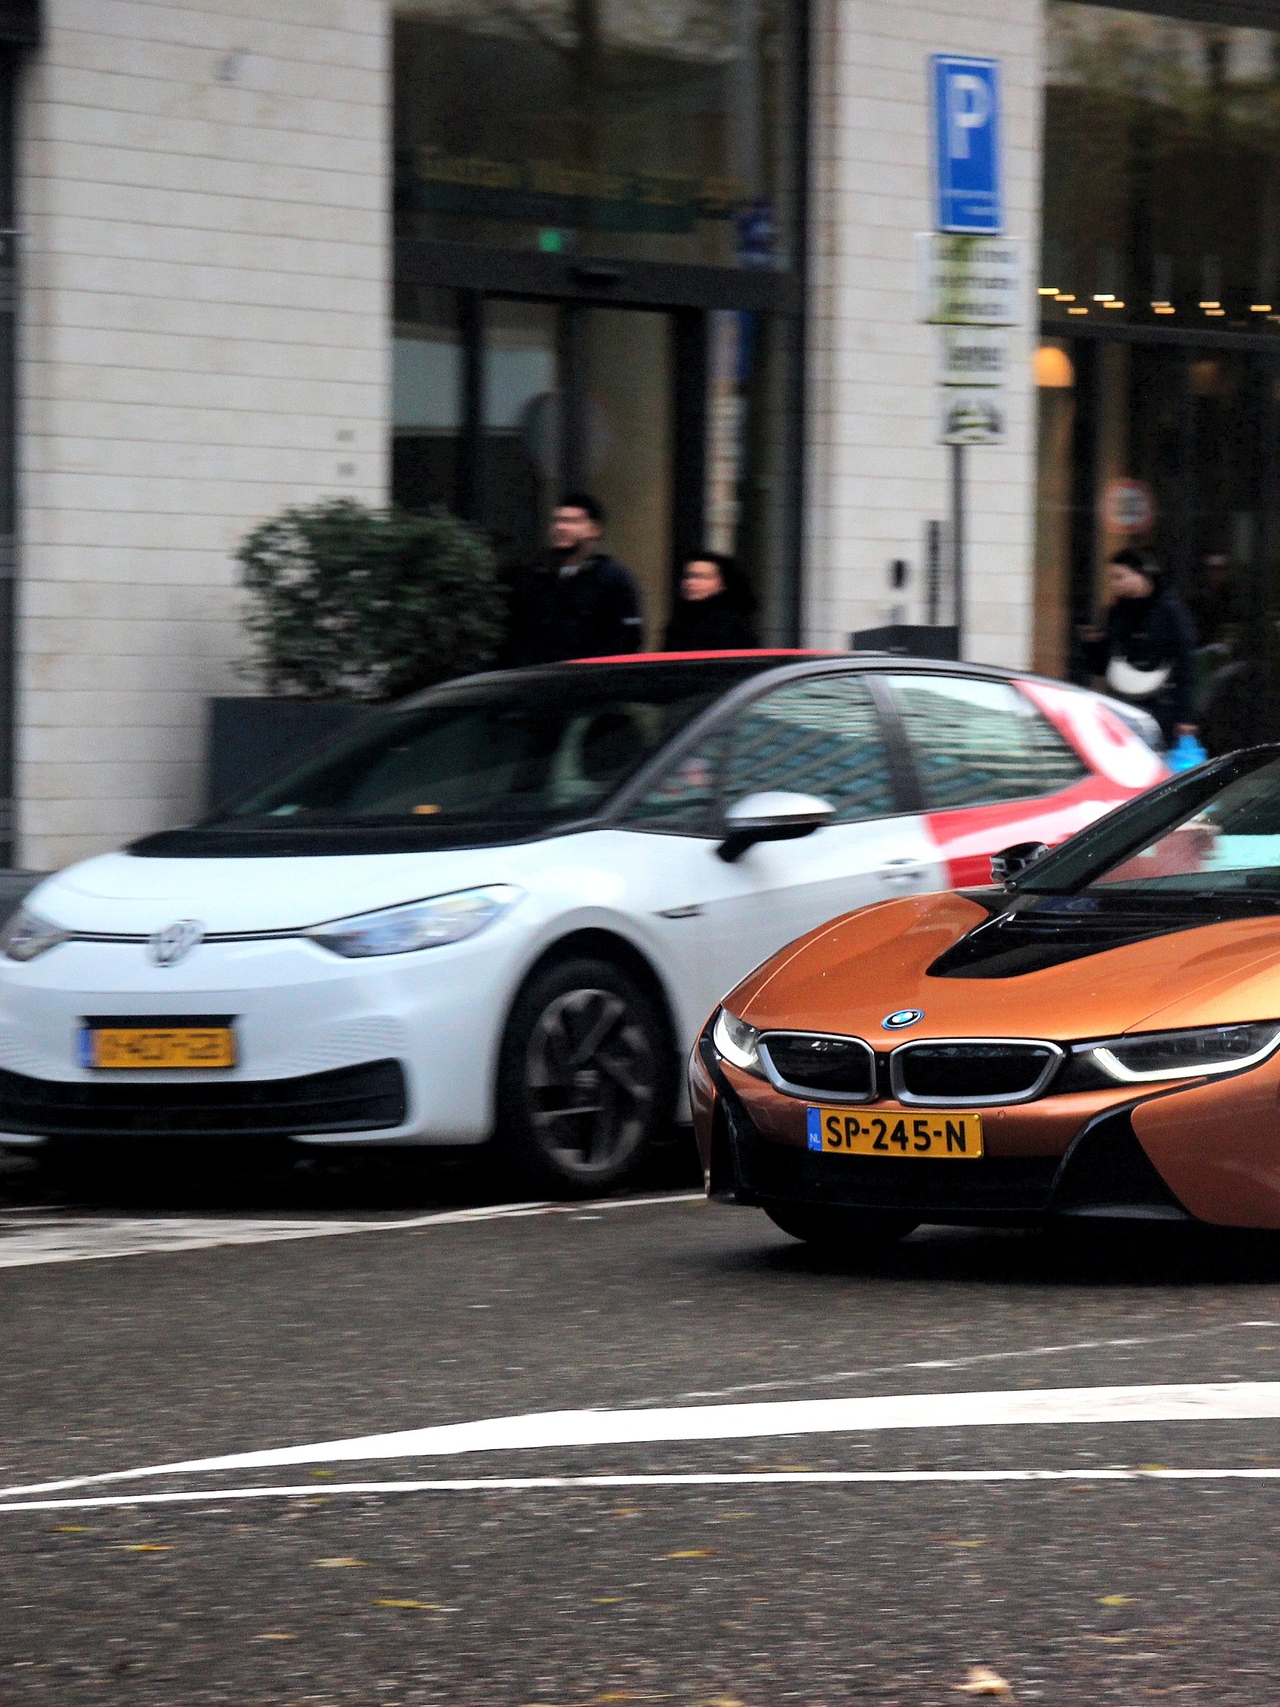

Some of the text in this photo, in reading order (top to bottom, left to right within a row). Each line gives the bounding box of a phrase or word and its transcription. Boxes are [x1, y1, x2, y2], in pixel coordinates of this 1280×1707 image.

[946, 74, 990, 159] P
[809, 1133, 821, 1144] NL
[826, 1115, 967, 1152] SP-245-N
